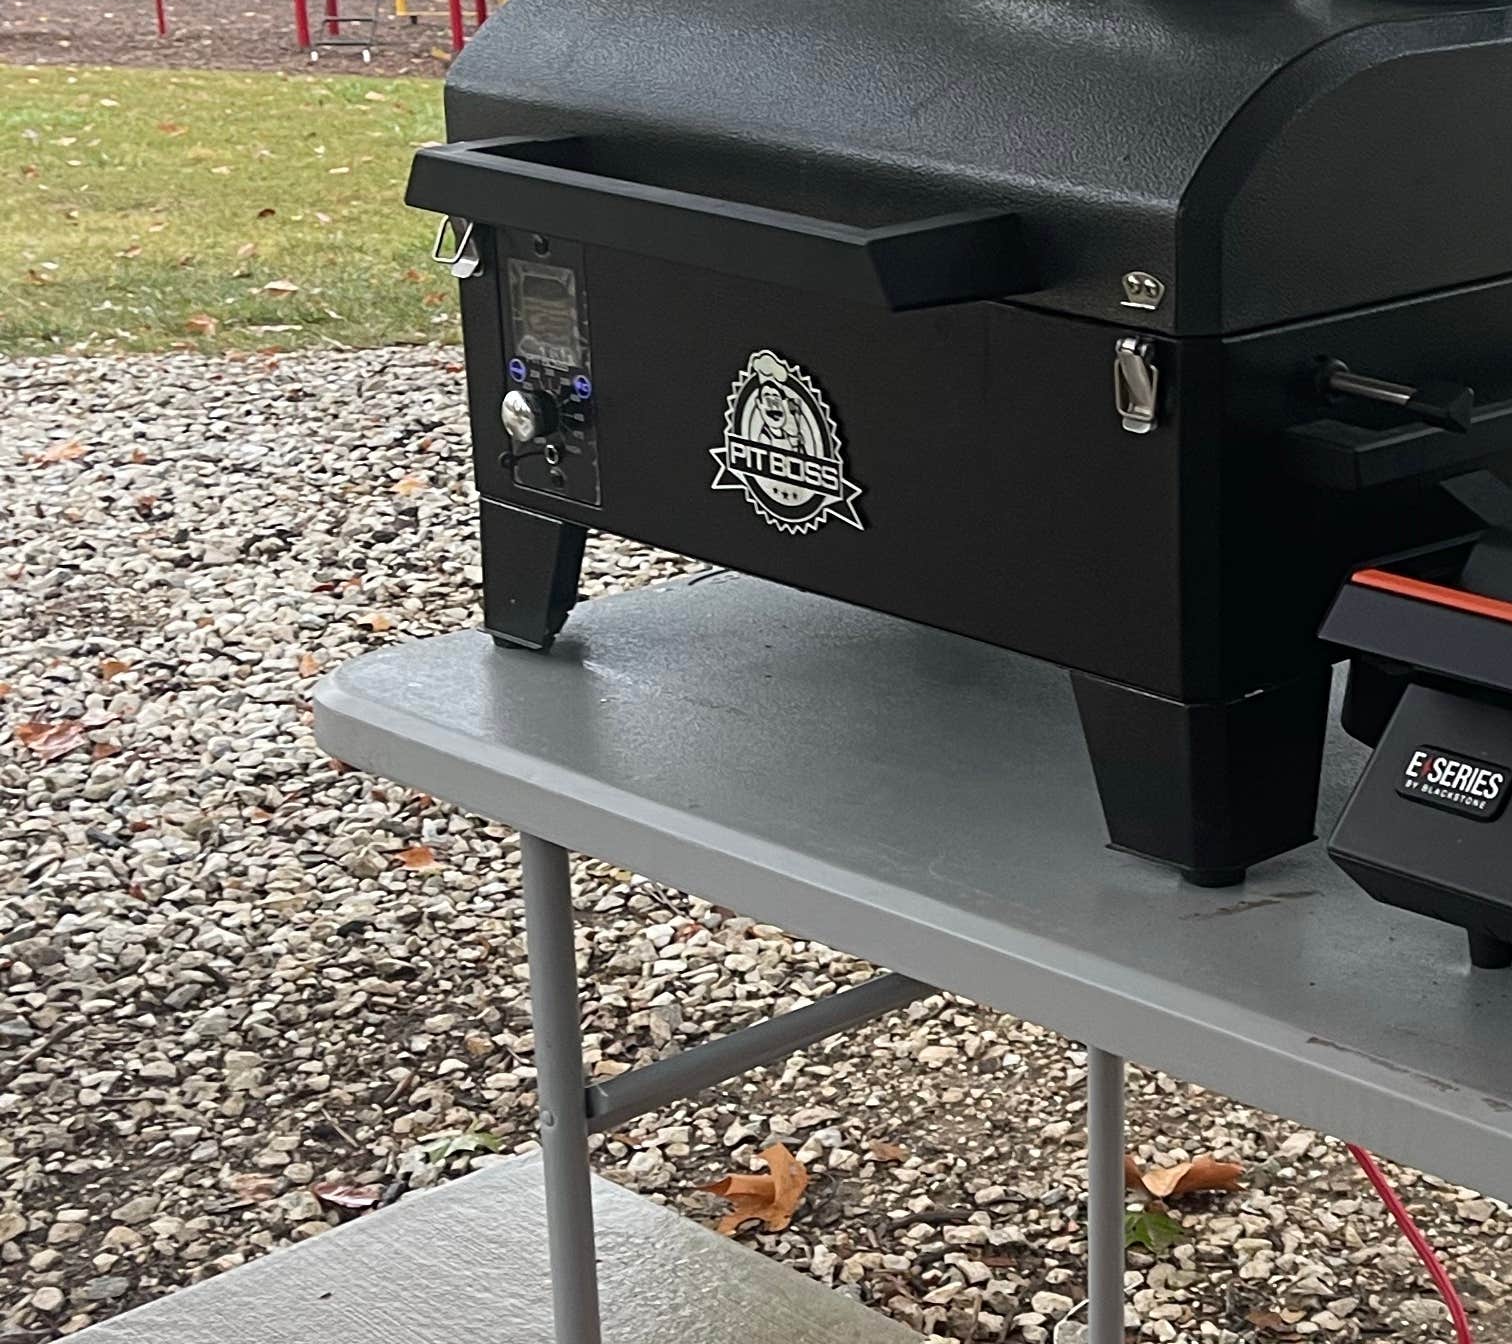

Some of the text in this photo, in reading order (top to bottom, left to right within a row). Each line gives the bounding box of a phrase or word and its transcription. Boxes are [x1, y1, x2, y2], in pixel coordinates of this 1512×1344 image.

[730, 441, 839, 491] PIT BOSS
[1420, 783, 1488, 810] BLACKSTONE
